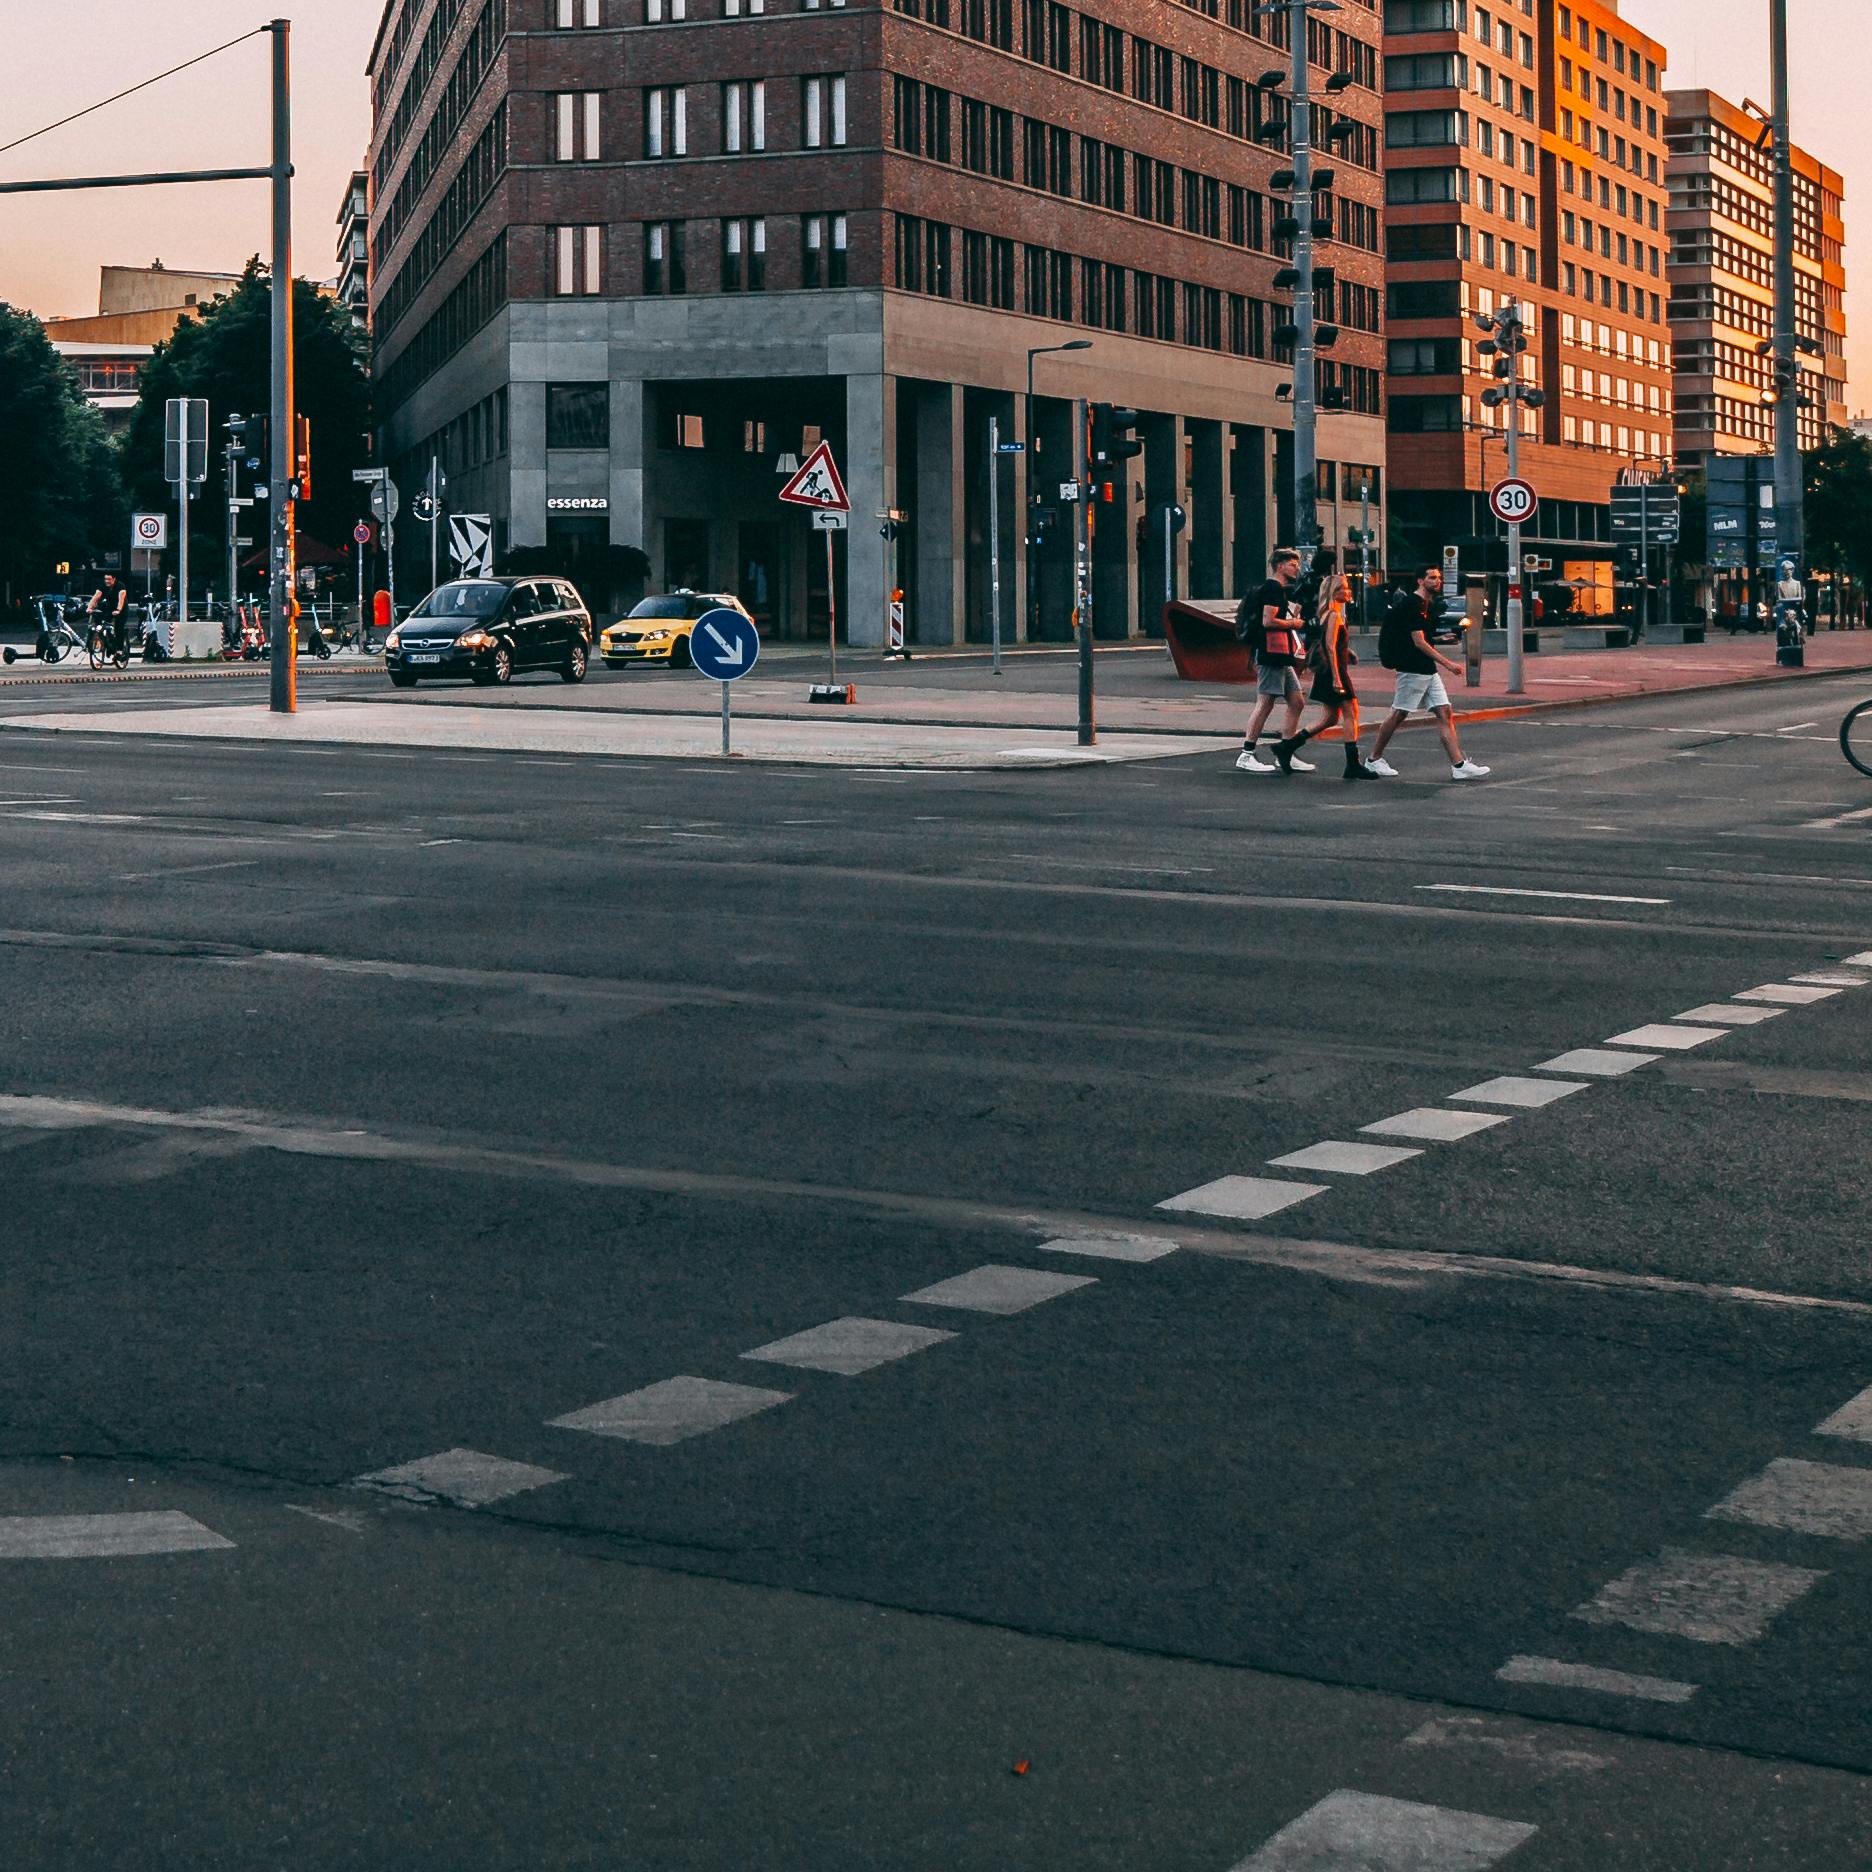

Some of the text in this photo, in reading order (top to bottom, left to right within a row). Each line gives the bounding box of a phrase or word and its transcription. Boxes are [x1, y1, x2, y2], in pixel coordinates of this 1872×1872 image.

[547, 498, 608, 509] essenza
[1499, 490, 1527, 510] 30
[143, 523, 155, 533] 30
